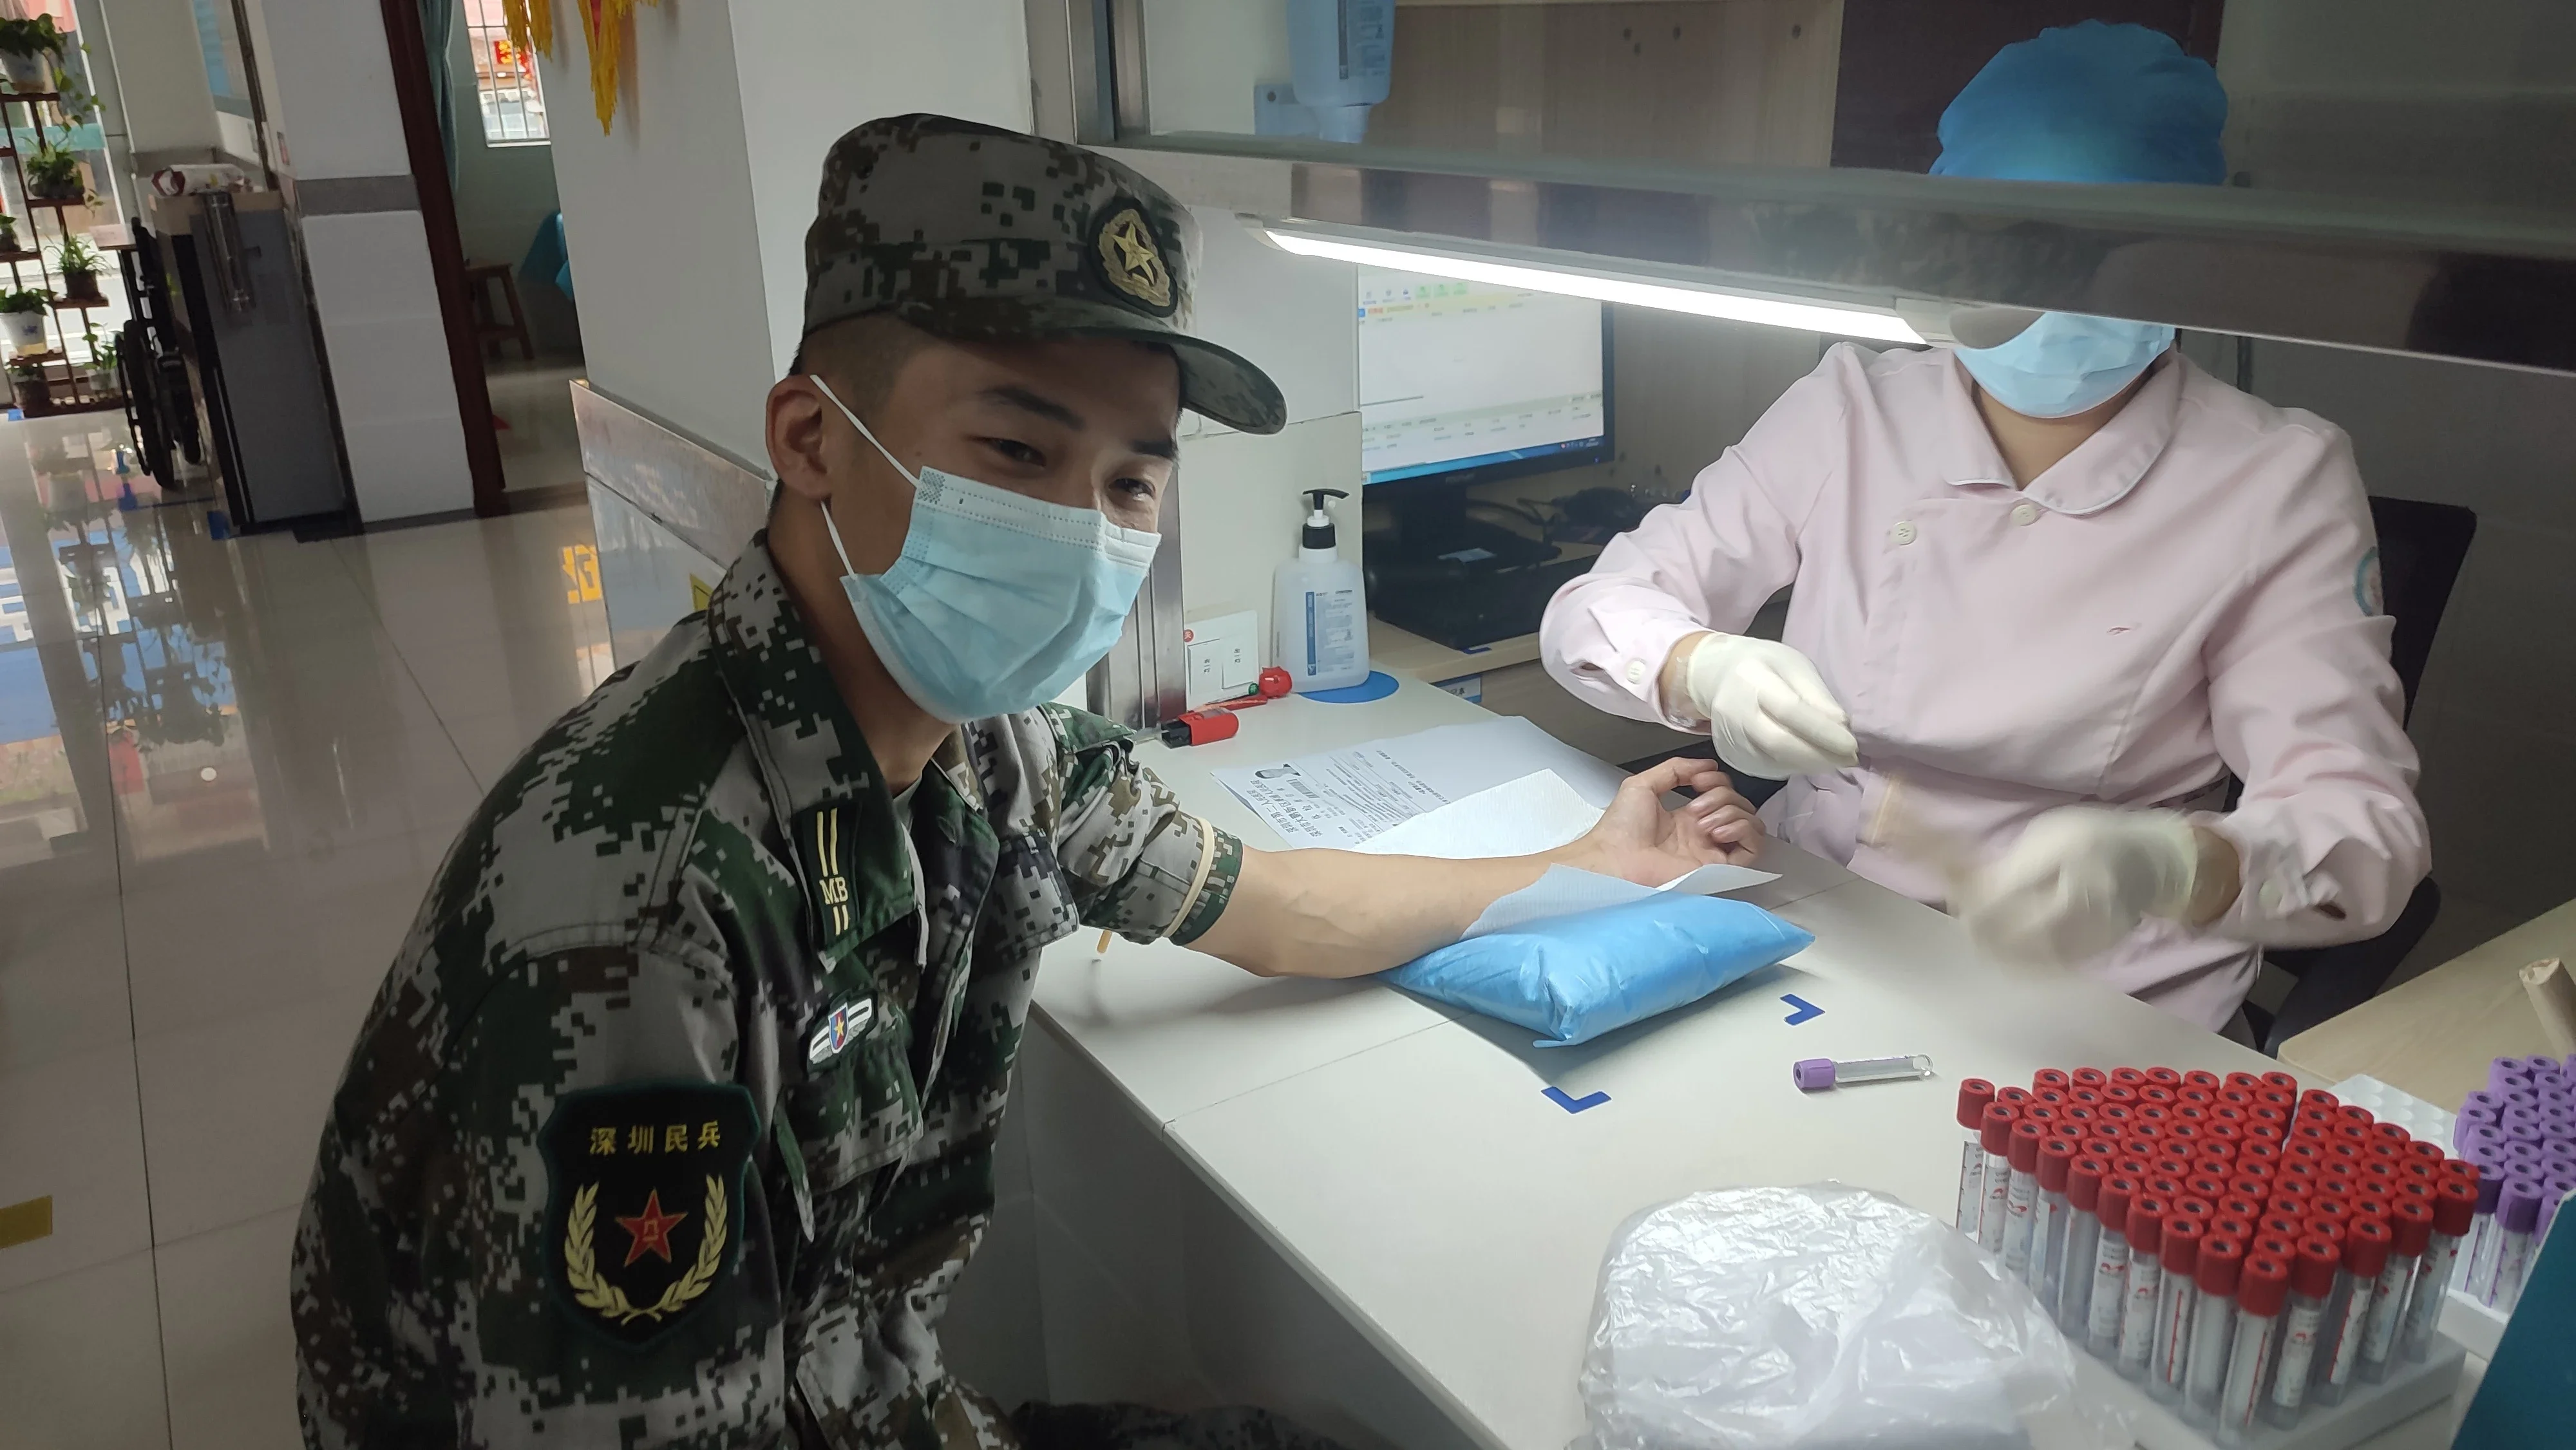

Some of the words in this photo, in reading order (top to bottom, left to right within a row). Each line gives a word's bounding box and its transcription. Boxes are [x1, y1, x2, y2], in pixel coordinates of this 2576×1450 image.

[819, 876, 848, 905] MB
[589, 1120, 721, 1156] 深圳民兵
